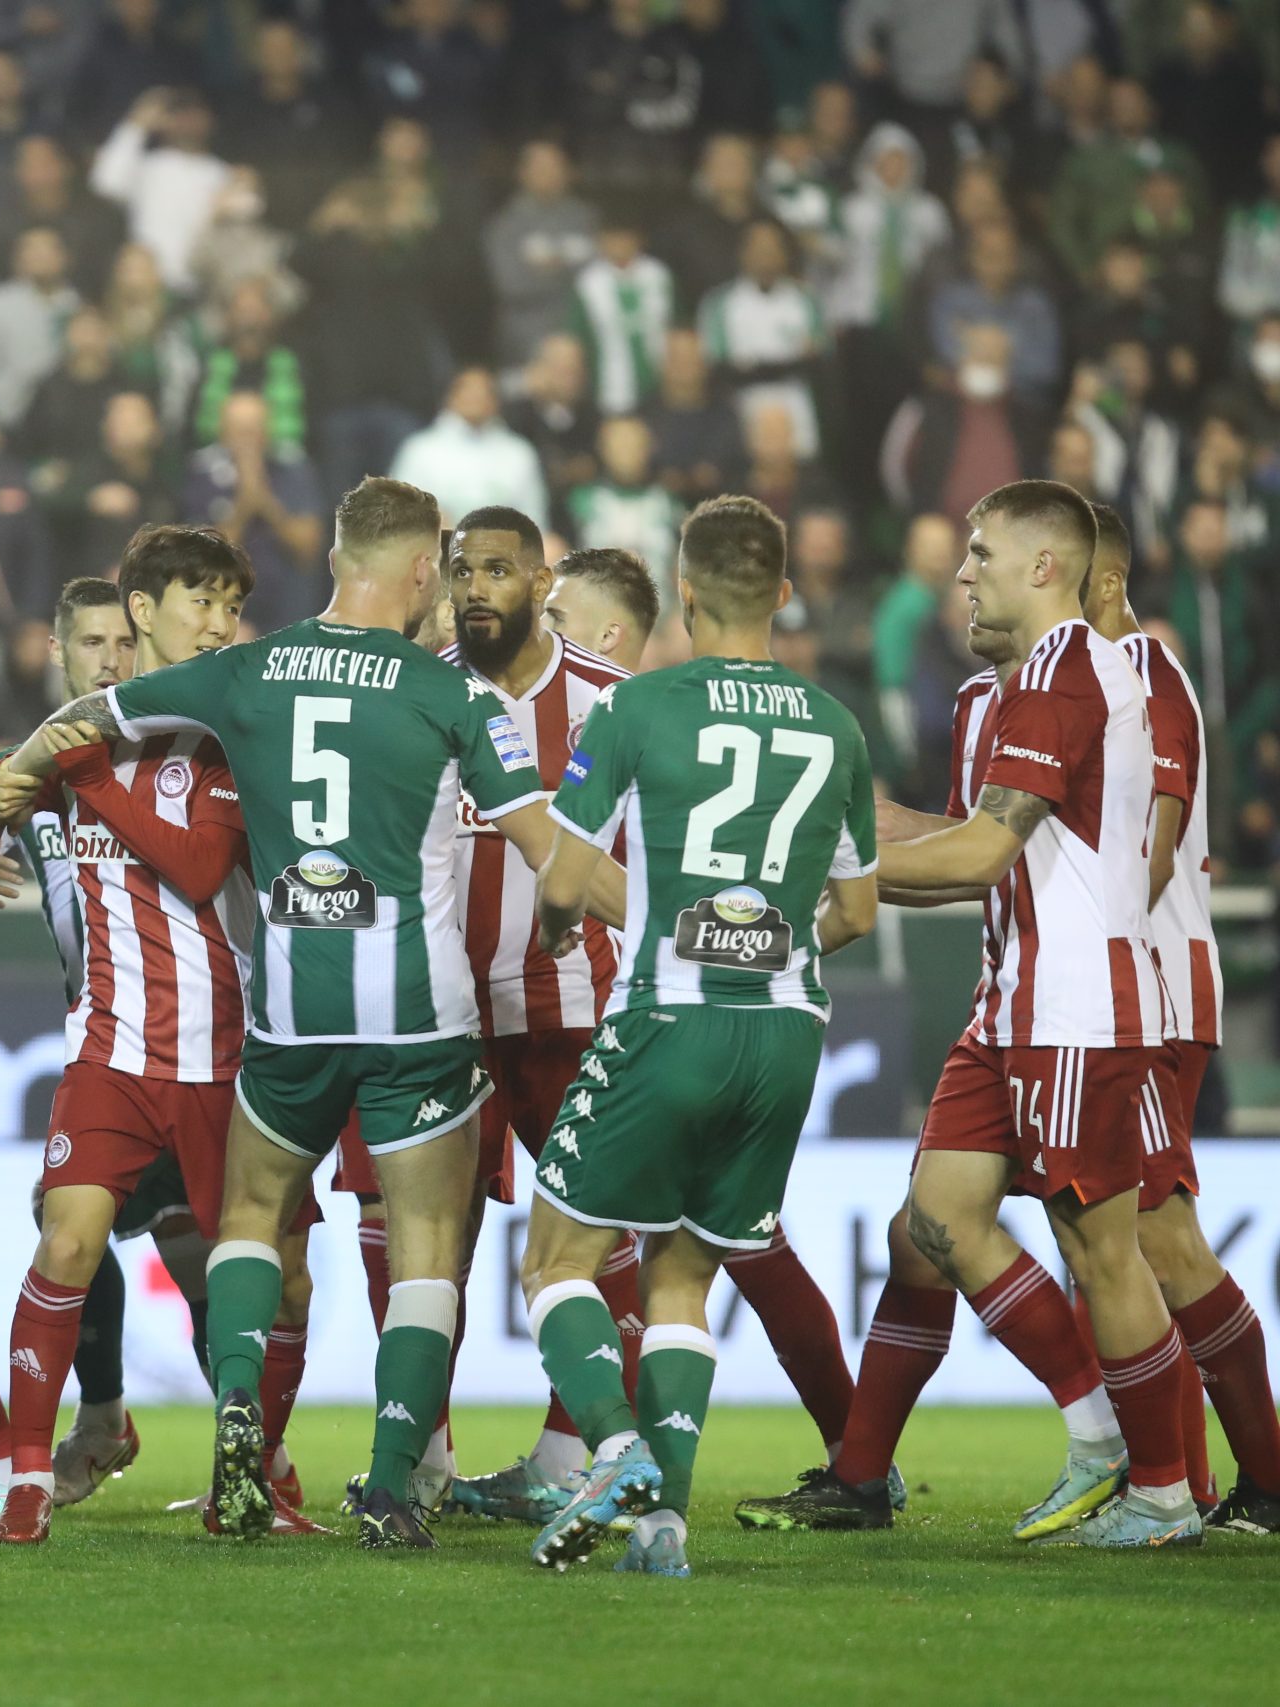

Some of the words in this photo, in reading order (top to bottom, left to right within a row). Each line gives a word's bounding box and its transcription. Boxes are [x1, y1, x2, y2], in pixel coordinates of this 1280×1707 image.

[262, 646, 402, 690] SCHENKEVELD
[291, 695, 352, 846] 5
[680, 723, 834, 883] 27
[311, 863, 337, 873] NIKAS
[285, 887, 360, 921] Fuego
[728, 898, 754, 910] NIKAS
[692, 921, 773, 962] Fuego
[1009, 1075, 1044, 1144] 74
